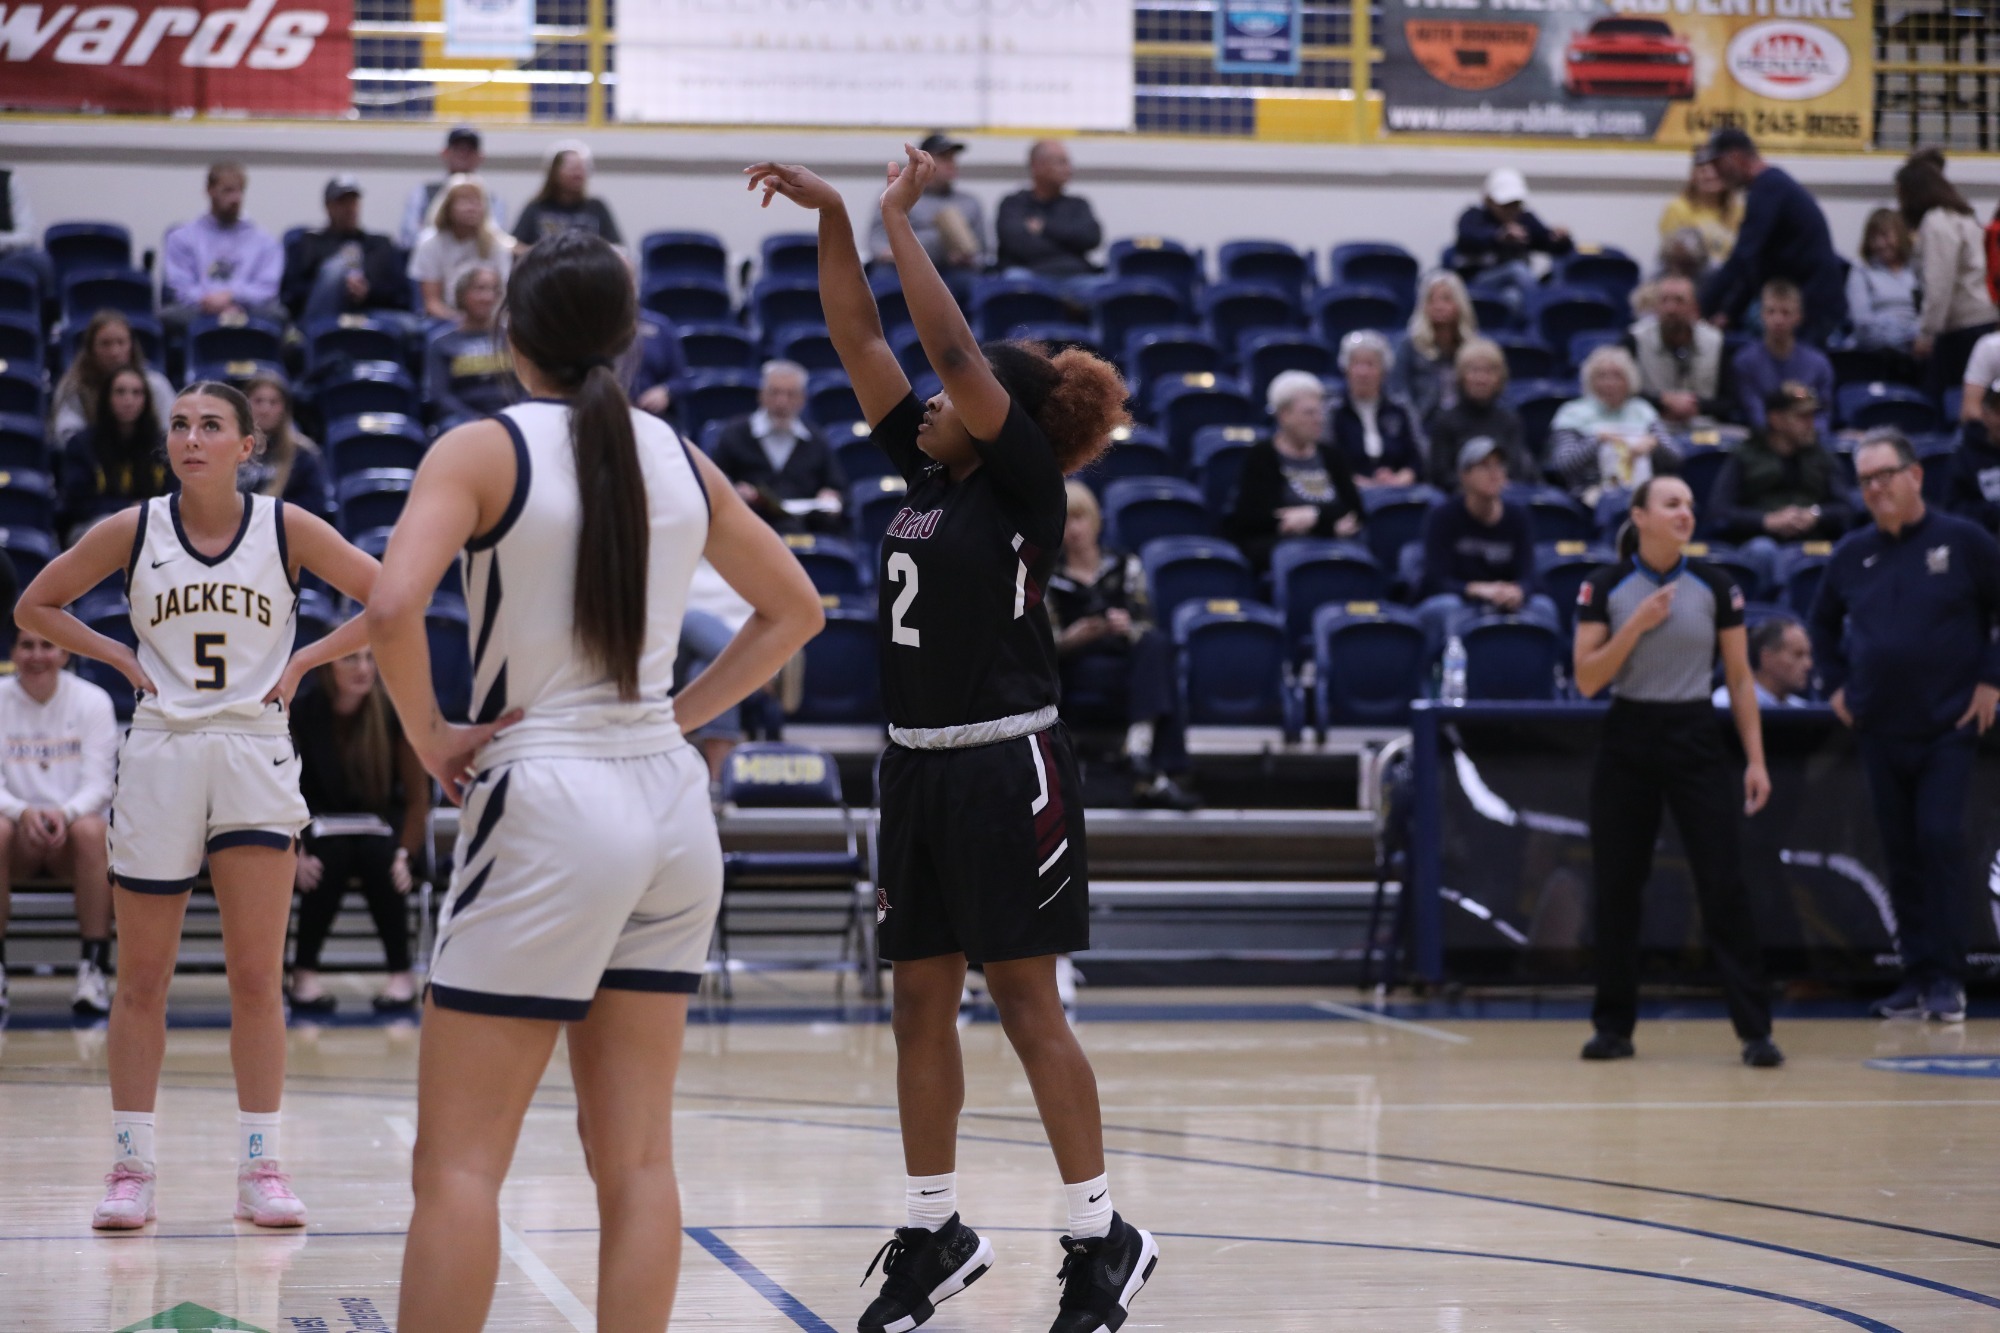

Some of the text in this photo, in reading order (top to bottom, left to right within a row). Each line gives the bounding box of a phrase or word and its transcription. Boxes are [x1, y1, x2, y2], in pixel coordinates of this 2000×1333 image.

[150, 582, 271, 628] JACKETS
[887, 551, 920, 648] 2
[194, 632, 226, 691] 5
